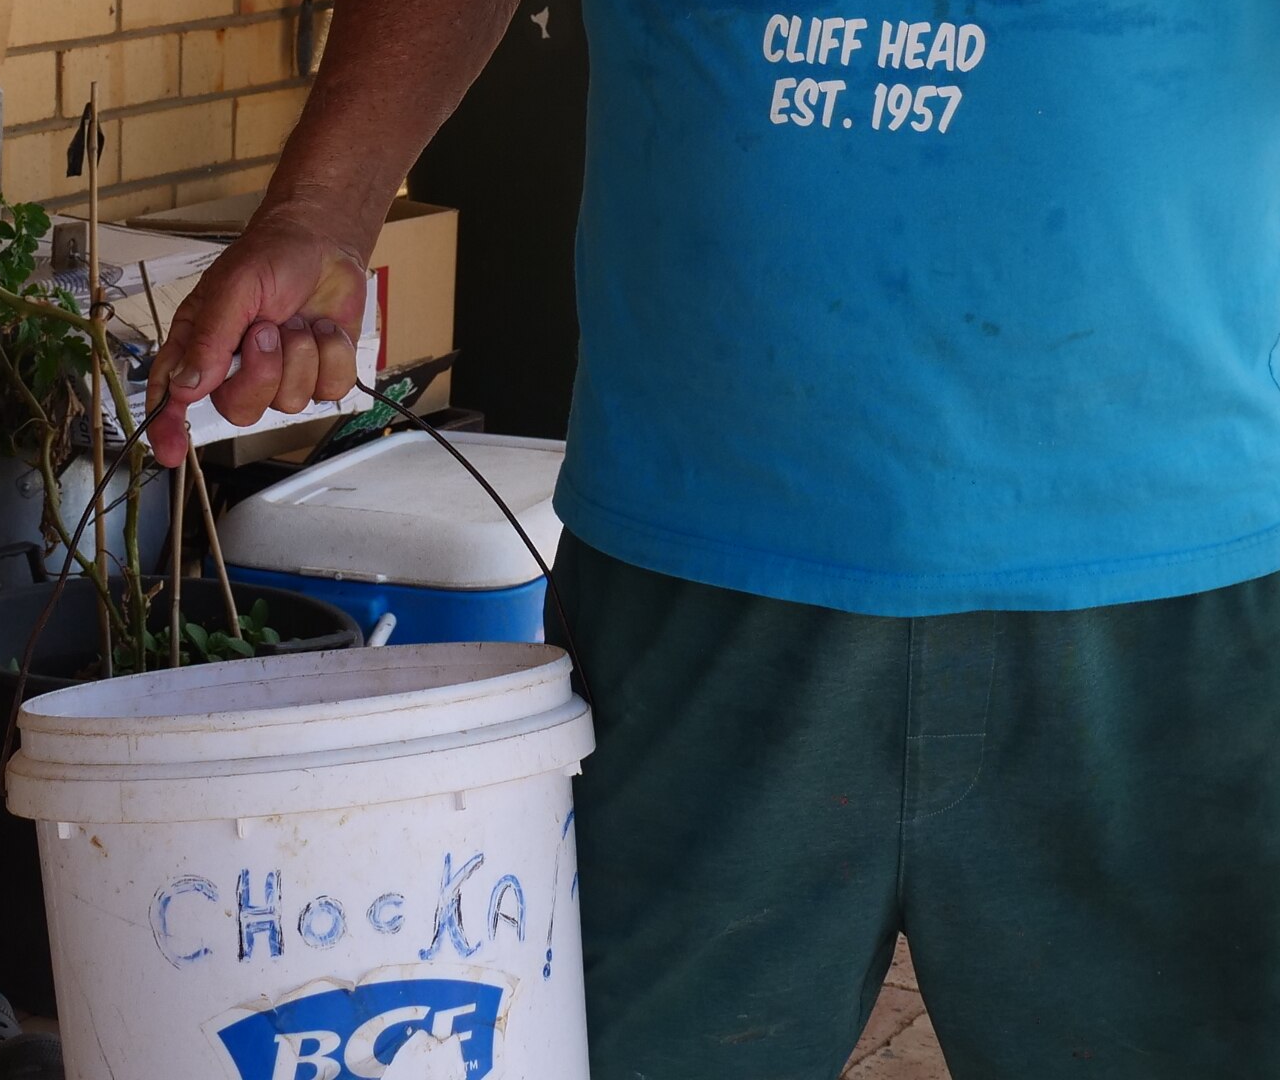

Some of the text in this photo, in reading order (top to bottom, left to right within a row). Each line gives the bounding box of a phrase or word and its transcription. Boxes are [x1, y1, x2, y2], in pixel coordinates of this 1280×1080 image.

[763, 14, 986, 73] CLIFF HEAD
[769, 77, 964, 134] EST. 1957
